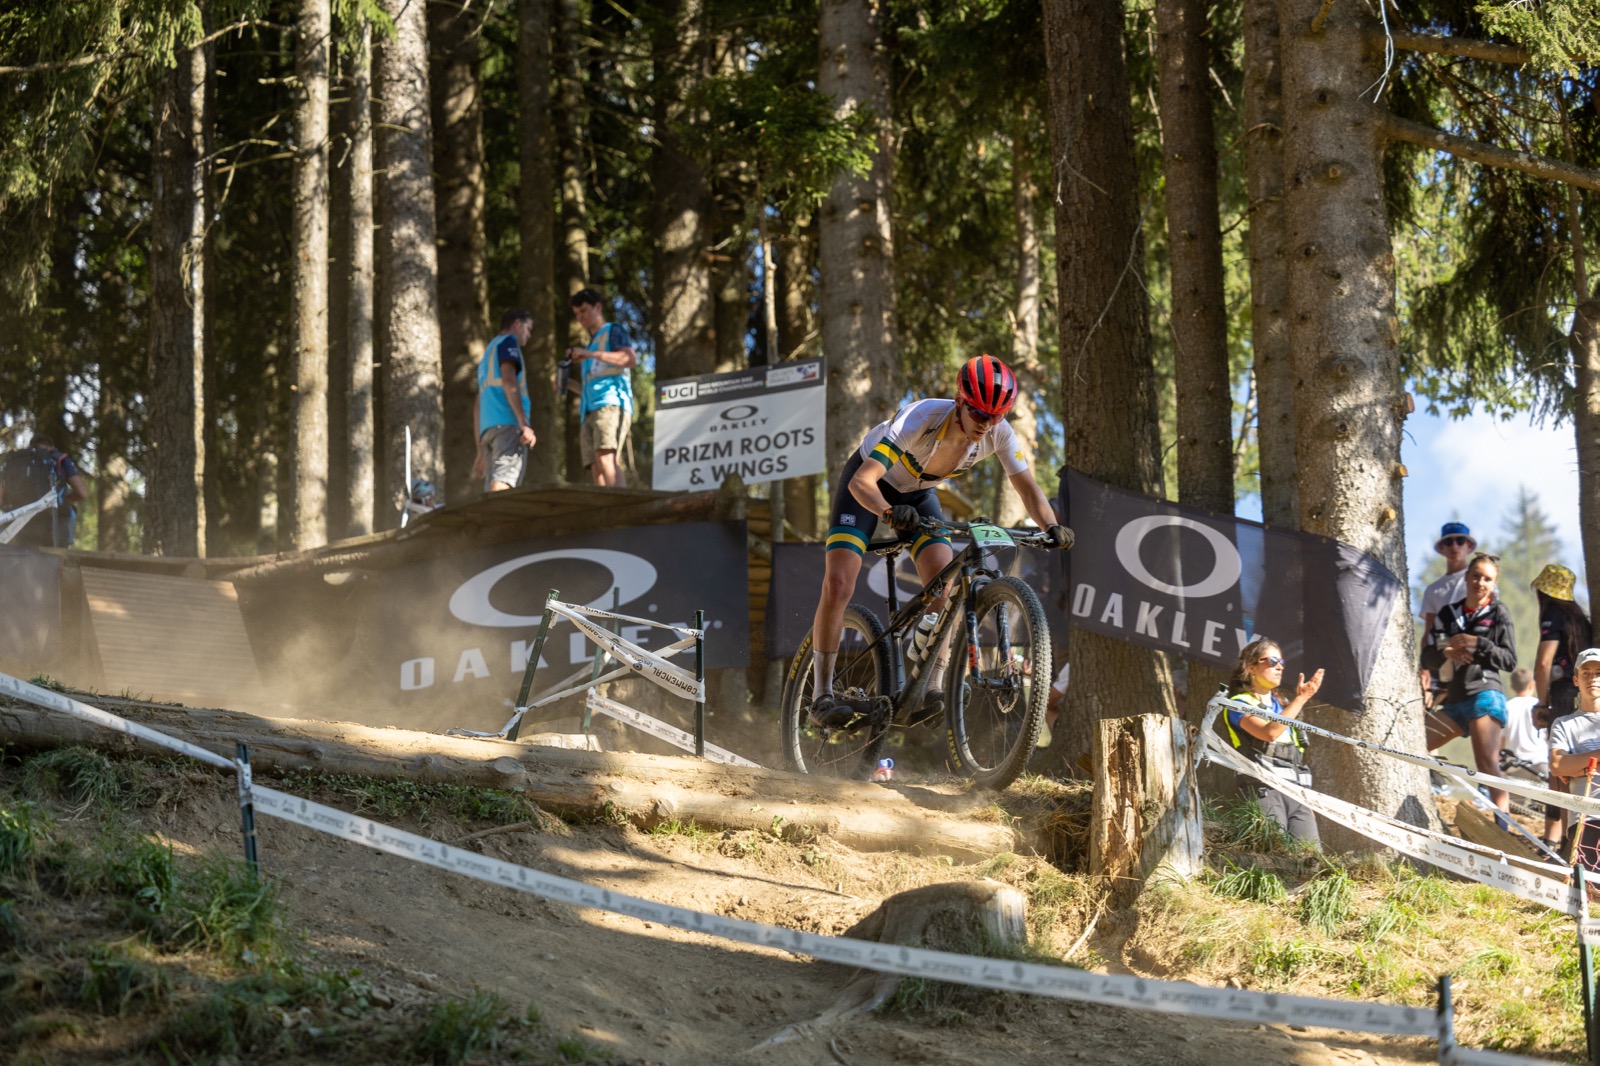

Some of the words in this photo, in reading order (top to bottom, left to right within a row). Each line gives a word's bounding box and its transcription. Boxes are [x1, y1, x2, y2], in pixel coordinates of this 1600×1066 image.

[667, 386, 694, 399] UCI
[710, 418, 769, 433] OAKLEY
[664, 440, 733, 465] PRIZM
[740, 427, 815, 455] ROOTS
[689, 468, 704, 485] &
[711, 455, 788, 483] WINGS
[980, 529, 1003, 538] 73
[1071, 582, 1262, 658] OAKLEY
[790, 636, 811, 680] MAXXIS
[653, 666, 698, 696] COMMENCAL
